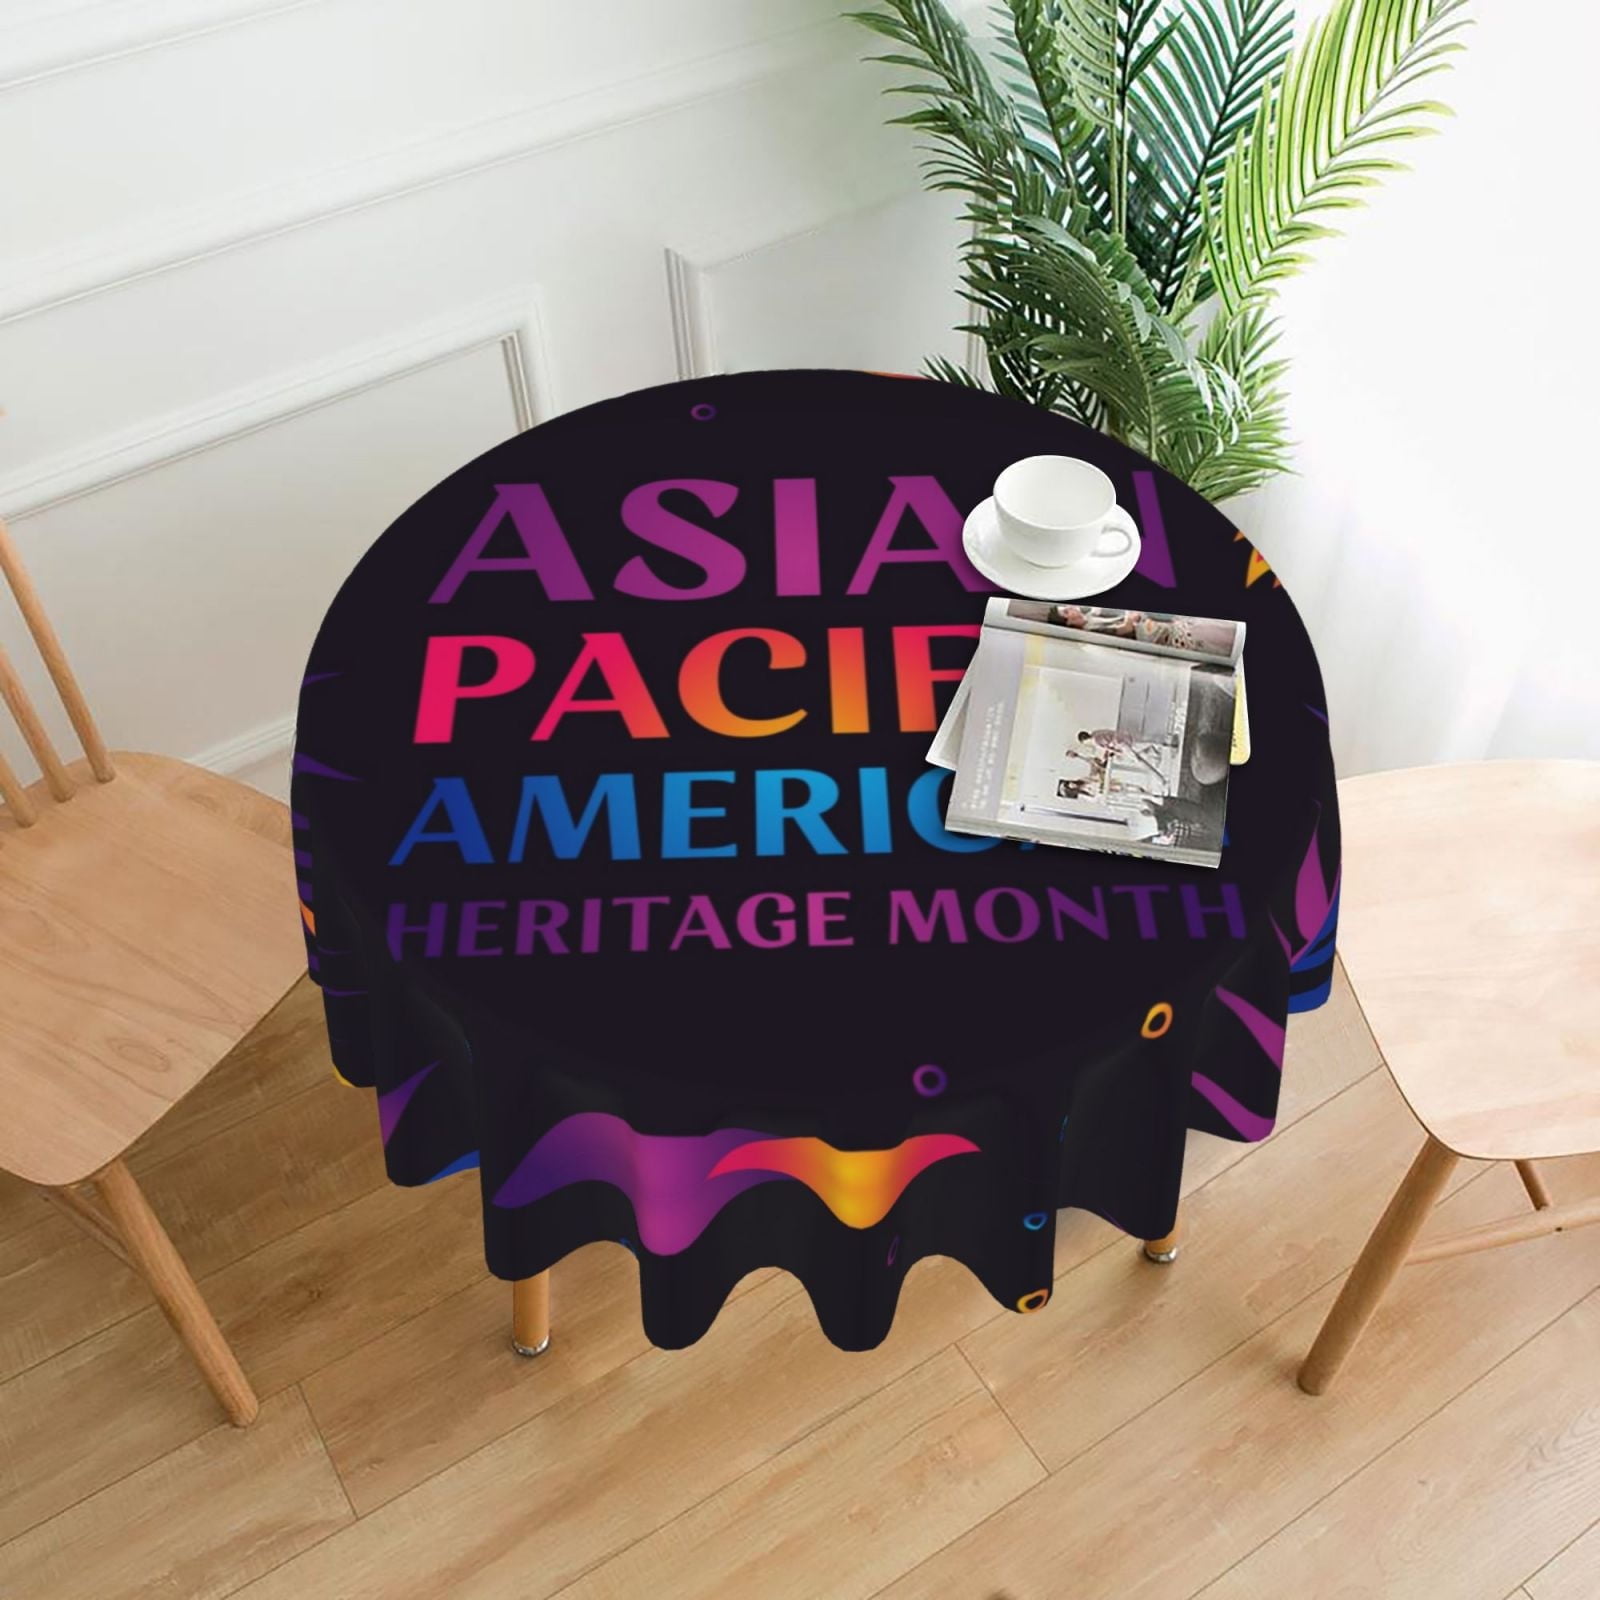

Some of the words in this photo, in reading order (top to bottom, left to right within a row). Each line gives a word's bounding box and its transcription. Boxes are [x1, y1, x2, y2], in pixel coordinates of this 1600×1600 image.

[413, 624, 984, 744] PACIF
[386, 891, 854, 962] HERITAGE
[889, 883, 1247, 946] MONTH
